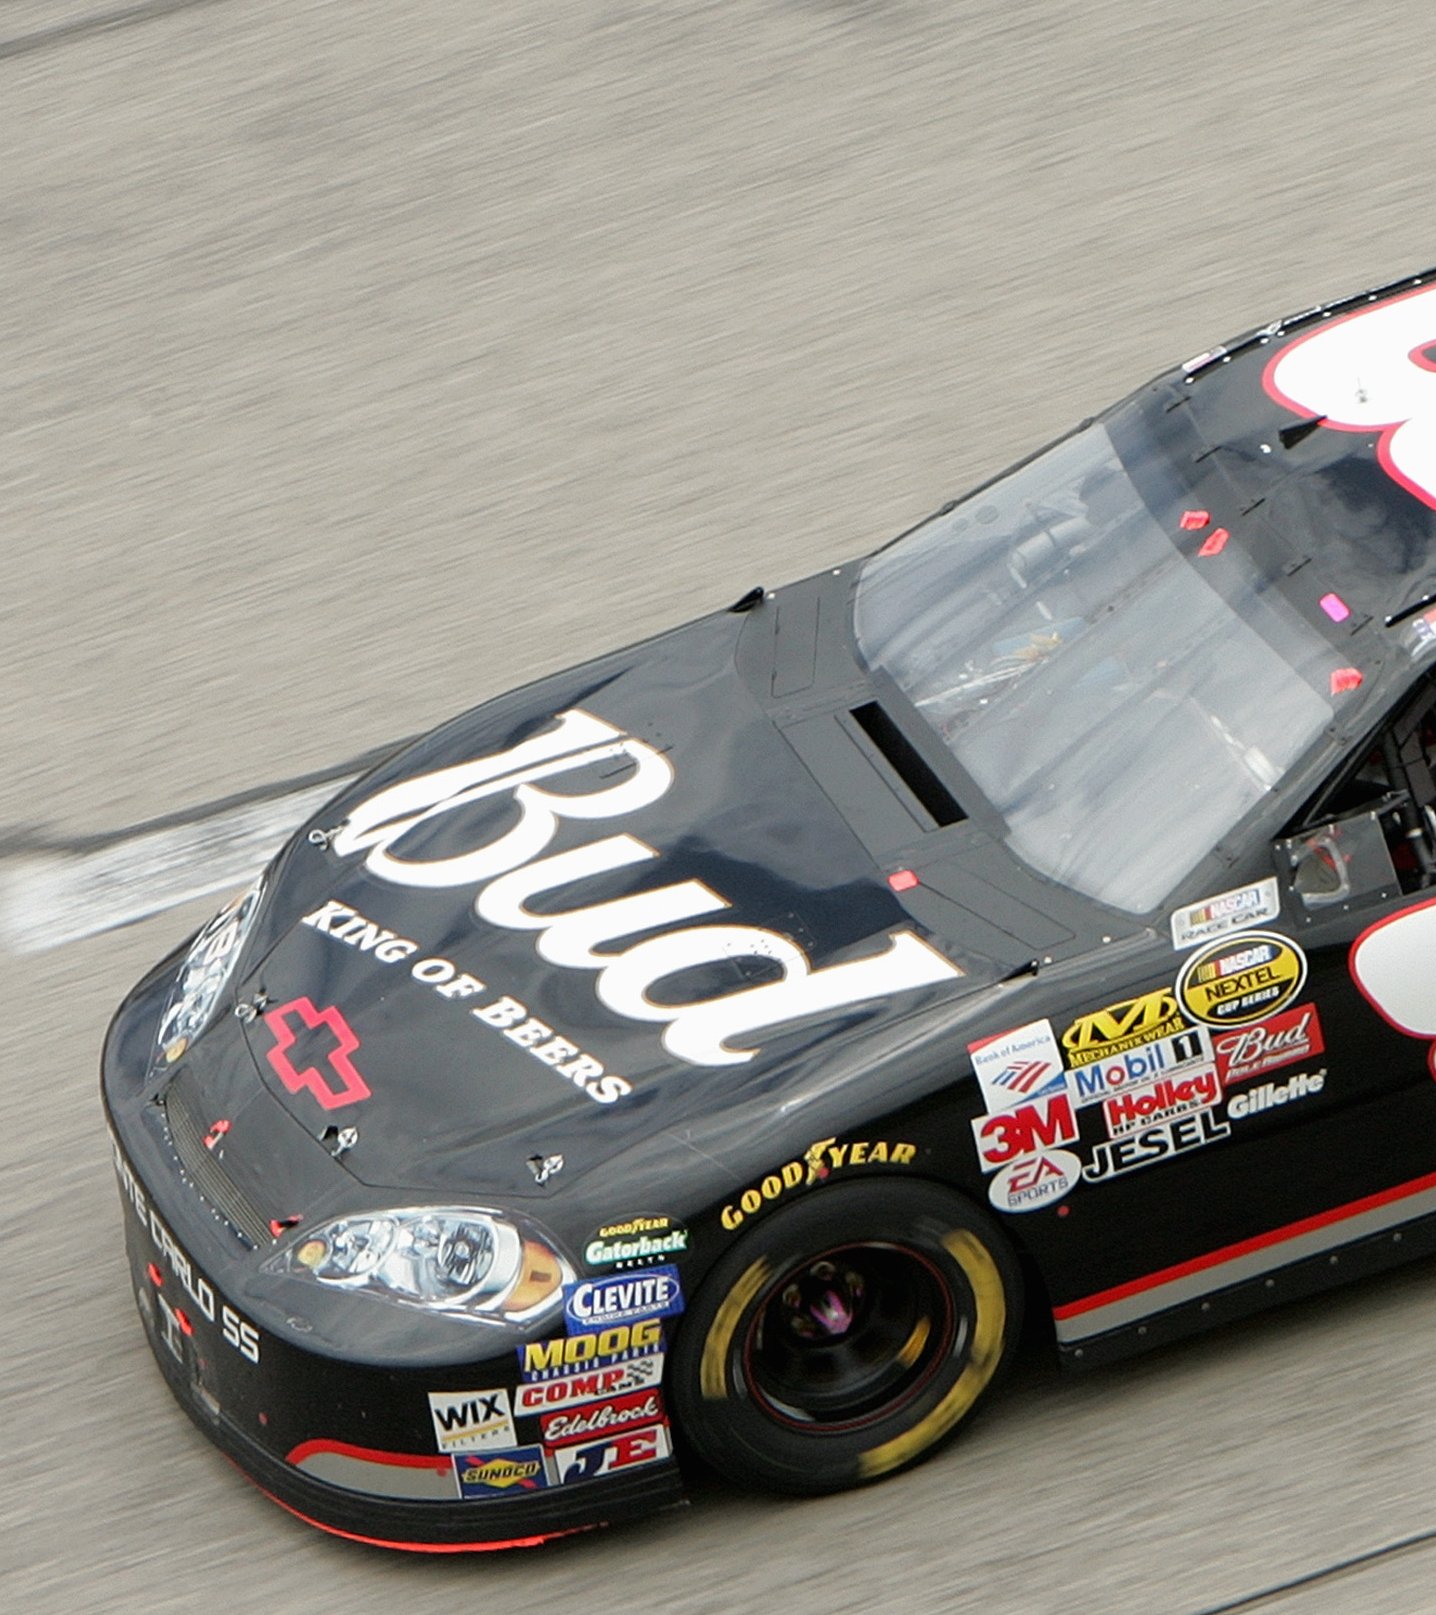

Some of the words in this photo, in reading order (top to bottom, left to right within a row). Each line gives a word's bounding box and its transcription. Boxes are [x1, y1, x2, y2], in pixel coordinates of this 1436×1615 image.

[332, 708, 964, 1068] Bud
[1231, 907, 1268, 924] CAR
[303, 900, 418, 965] KING
[412, 957, 487, 1001] OF
[473, 995, 634, 1104] BEERS
[1204, 966, 1281, 1002] NEXTEL
[1216, 999, 1240, 1016] CUP
[1143, 1016, 1185, 1042] WEAR
[1217, 1012, 1311, 1067] Bud
[1074, 1043, 1165, 1097] Mobil
[1175, 1032, 1198, 1062] 1
[1107, 1071, 1217, 1126] Holley
[1227, 1072, 1324, 1119] Gillette
[981, 1095, 1075, 1163] 3M
[1083, 1110, 1232, 1183] JESEL
[720, 1137, 918, 1231] GOODYEAR
[1007, 1156, 1064, 1194] EA
[1007, 1177, 1069, 1207] SPORTS
[585, 1230, 688, 1265] Gatorback
[599, 1218, 669, 1237] GOODYEAR
[150, 1209, 215, 1322] CARLO
[222, 1304, 259, 1364] SS
[573, 1276, 669, 1318] CLEVITE
[524, 1318, 661, 1372] MOOG
[532, 1357, 599, 1381] CHASSIS
[611, 1344, 659, 1364] PARTS
[522, 1369, 625, 1408] COMP
[434, 1393, 506, 1431] WIX
[544, 1396, 659, 1440] Edelbrock
[442, 1426, 510, 1449] FILTERS
[563, 1428, 658, 1484] JE
[465, 1461, 537, 1482] SUNOCO
